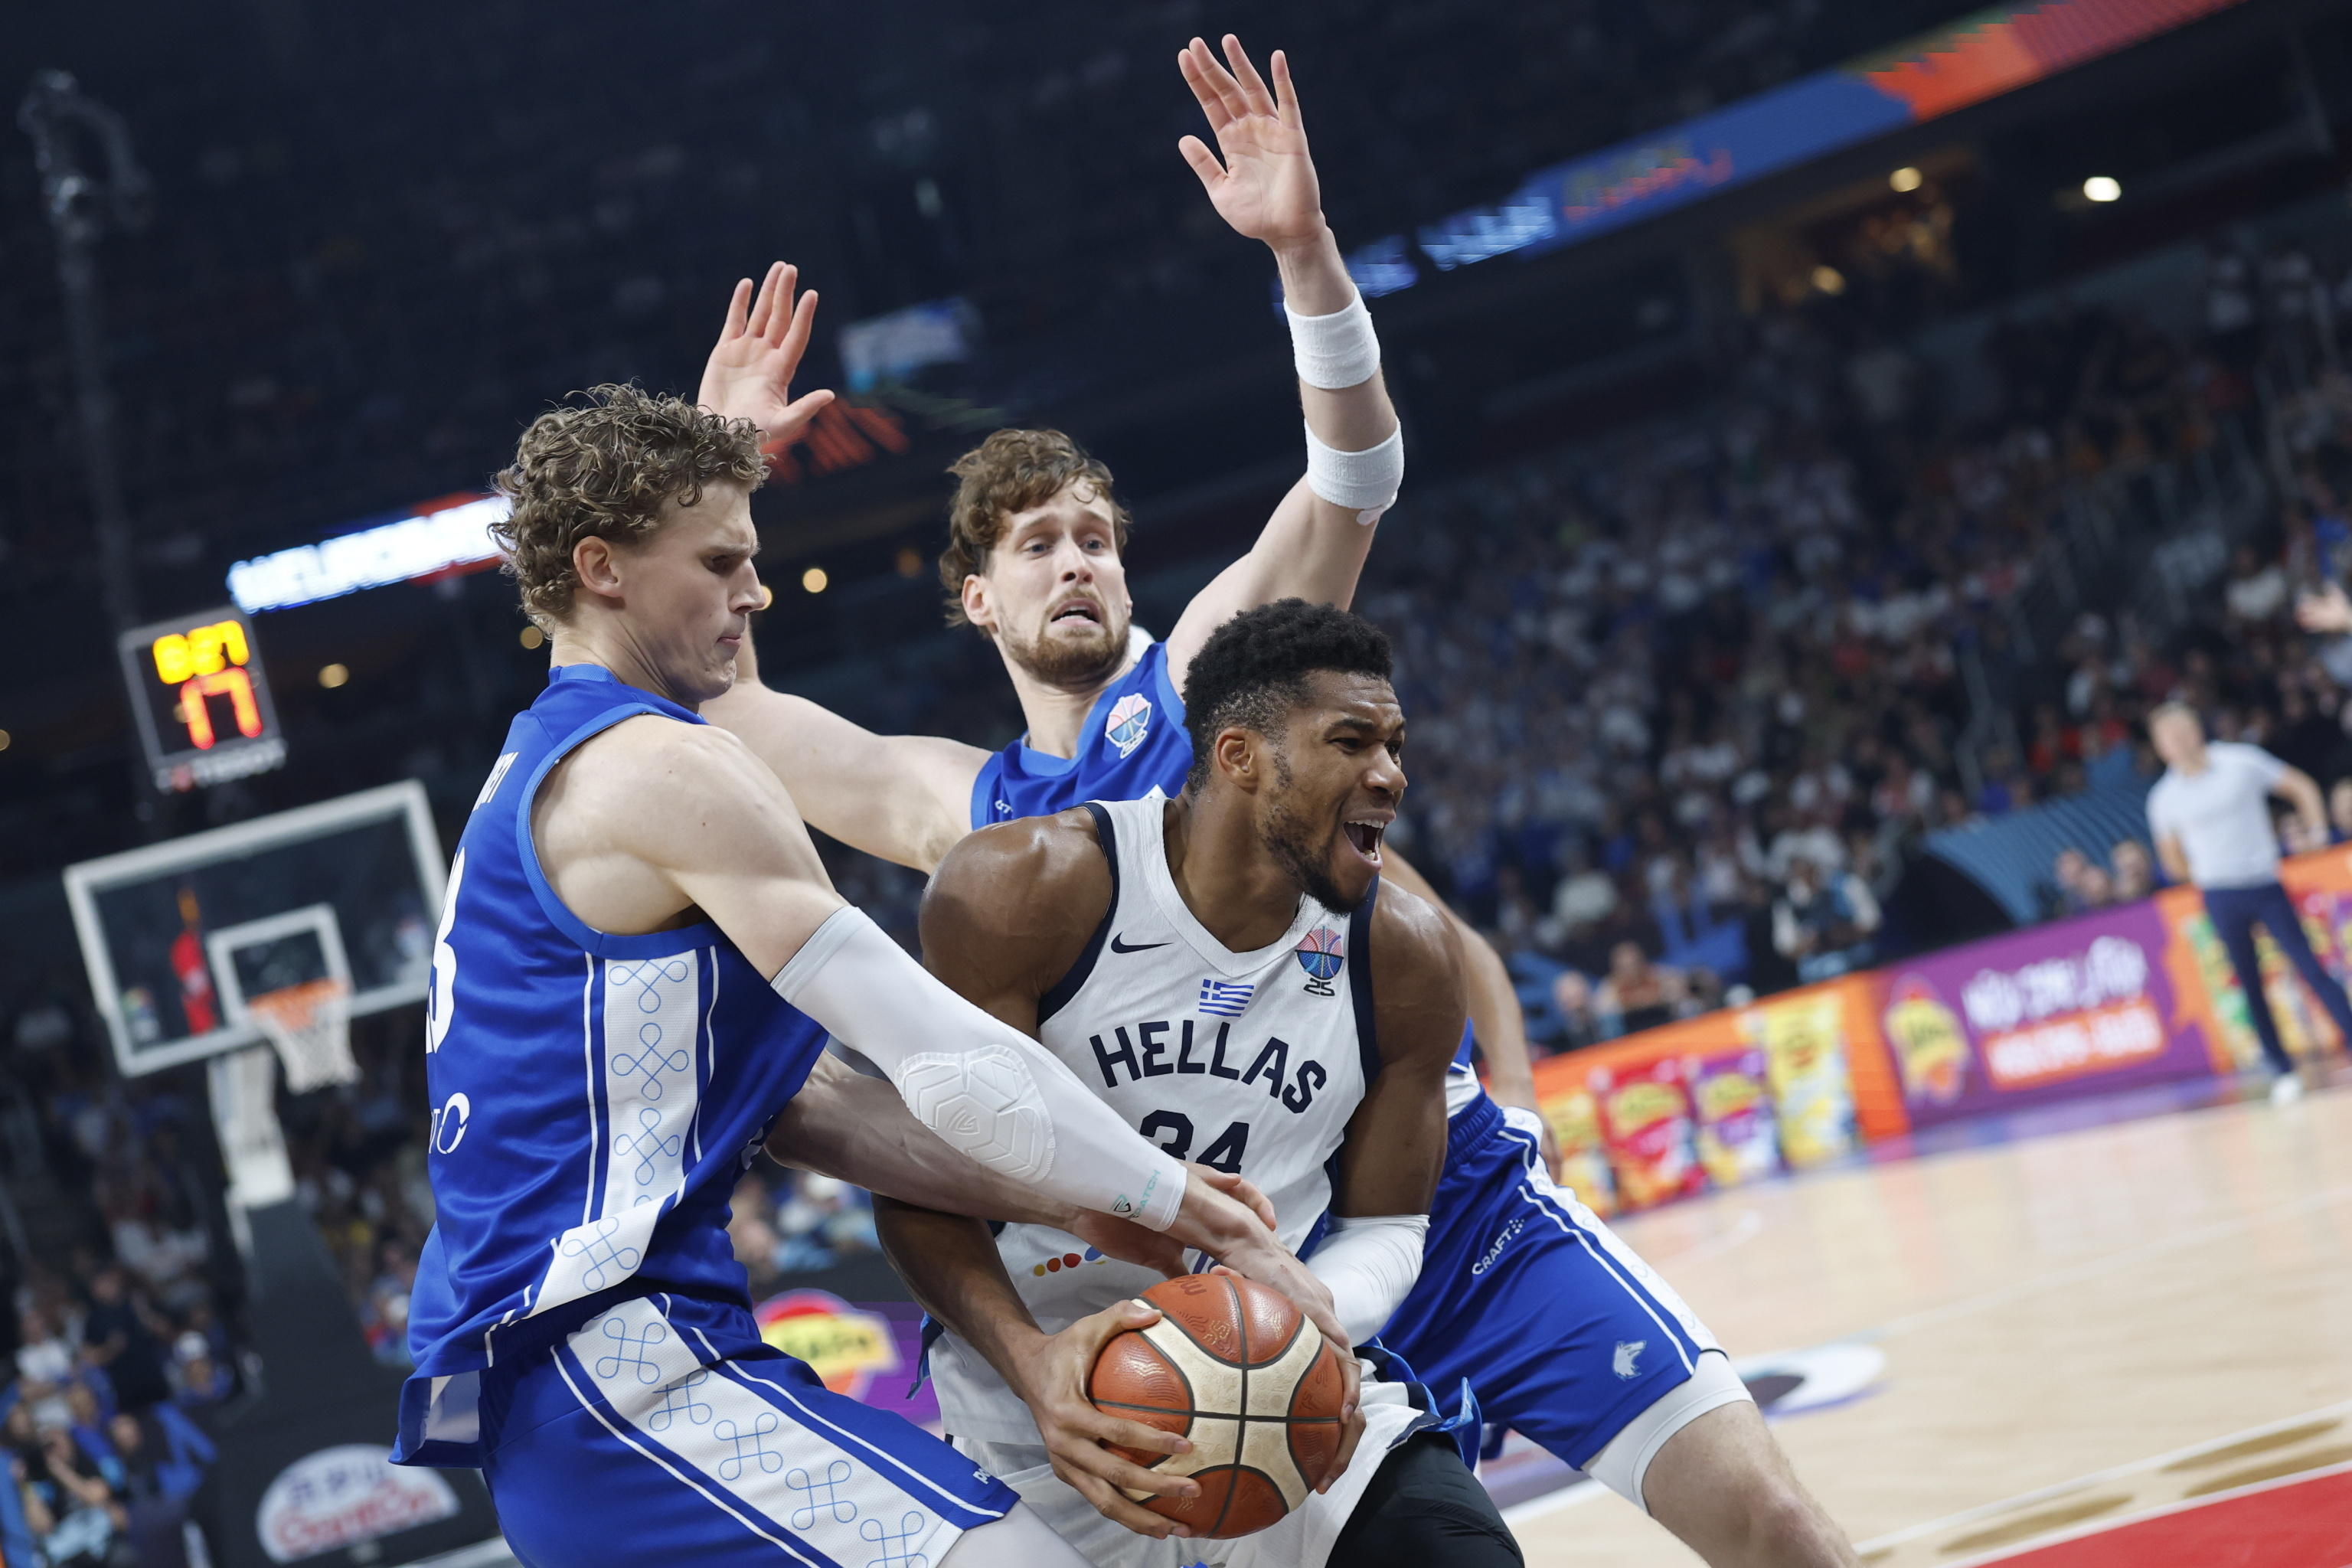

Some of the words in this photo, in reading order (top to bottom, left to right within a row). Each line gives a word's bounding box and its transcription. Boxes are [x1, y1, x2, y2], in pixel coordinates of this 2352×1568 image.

[426, 846, 466, 1054] 3
[1303, 977, 1335, 997] 25
[1089, 1019, 1327, 1114] HELLAS
[1140, 1109, 1250, 1174] 34
[1472, 1227, 1512, 1275] CRAFT
